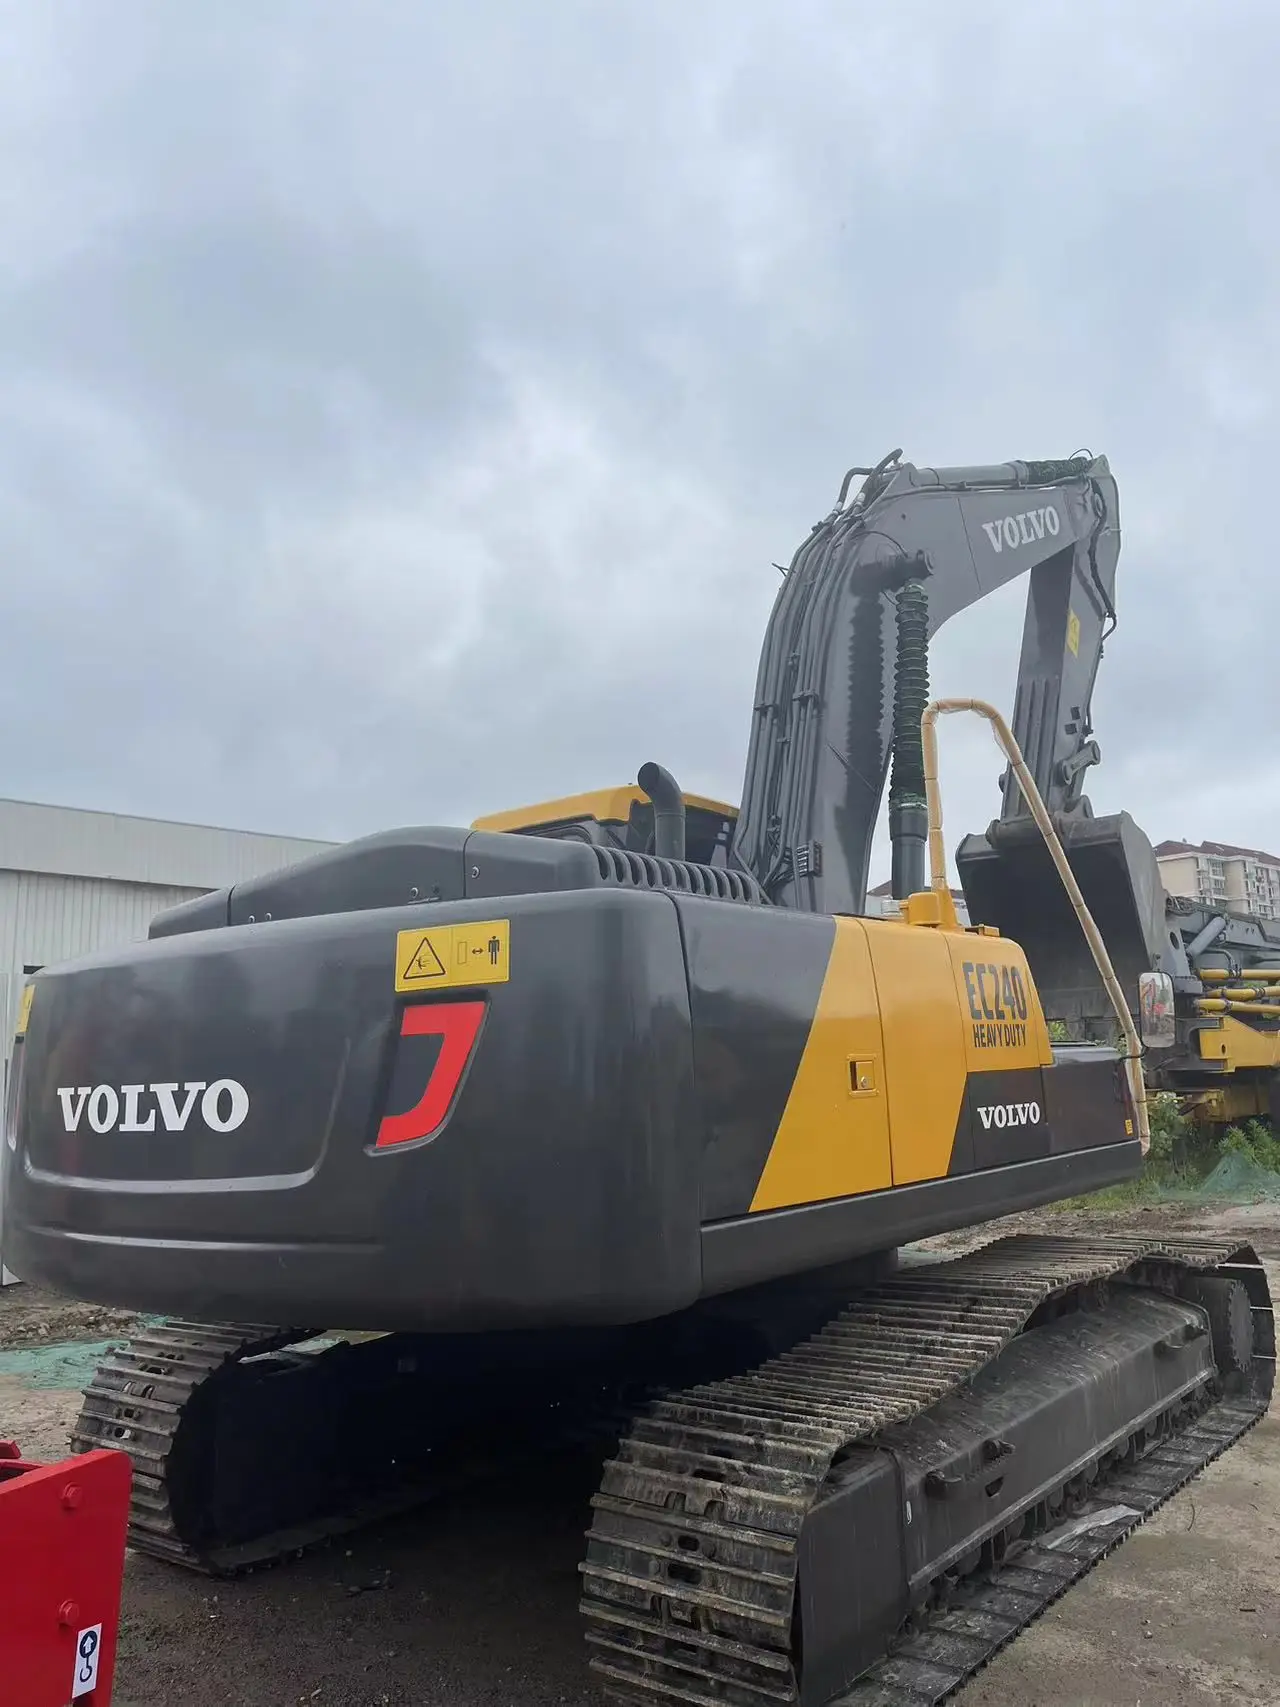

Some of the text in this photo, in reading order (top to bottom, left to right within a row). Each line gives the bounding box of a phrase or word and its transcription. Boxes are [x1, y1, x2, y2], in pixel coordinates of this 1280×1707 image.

[982, 506, 1060, 553] VOLVO
[962, 962, 1028, 1021] EC240
[973, 1024, 1026, 1048] HEAVY DUTY
[57, 1079, 250, 1133] VOLVO
[977, 1102, 1041, 1129] VOLVO
